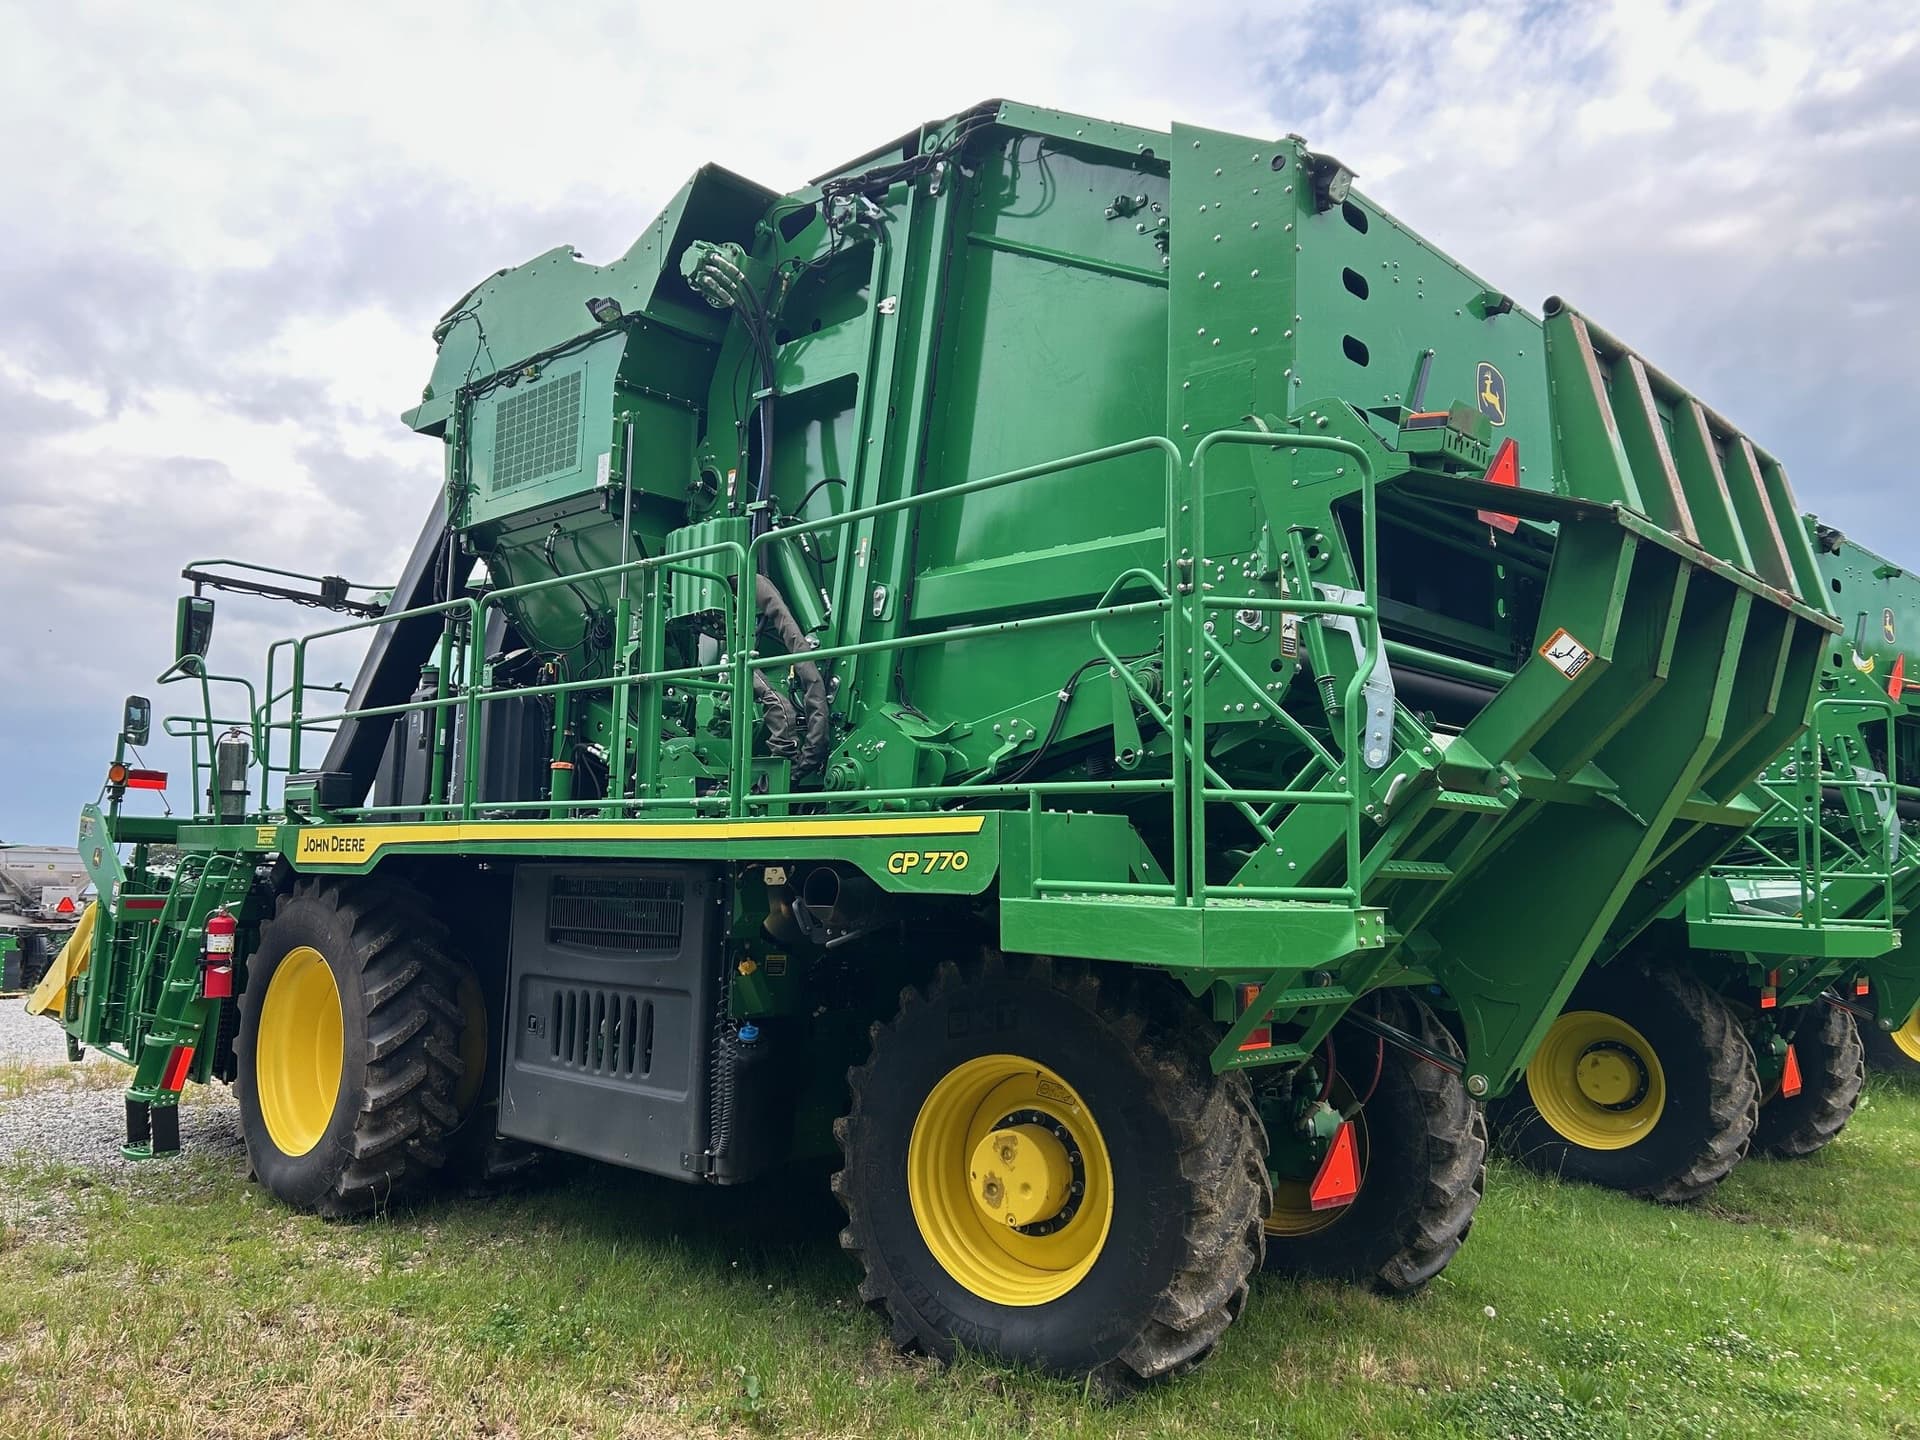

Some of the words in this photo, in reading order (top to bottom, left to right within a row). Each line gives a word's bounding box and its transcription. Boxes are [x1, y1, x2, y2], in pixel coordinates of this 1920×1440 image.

[304, 836, 329, 852] JOHN
[331, 835, 365, 852] DEERE
[887, 850, 920, 875] CP
[922, 850, 969, 875] 770
